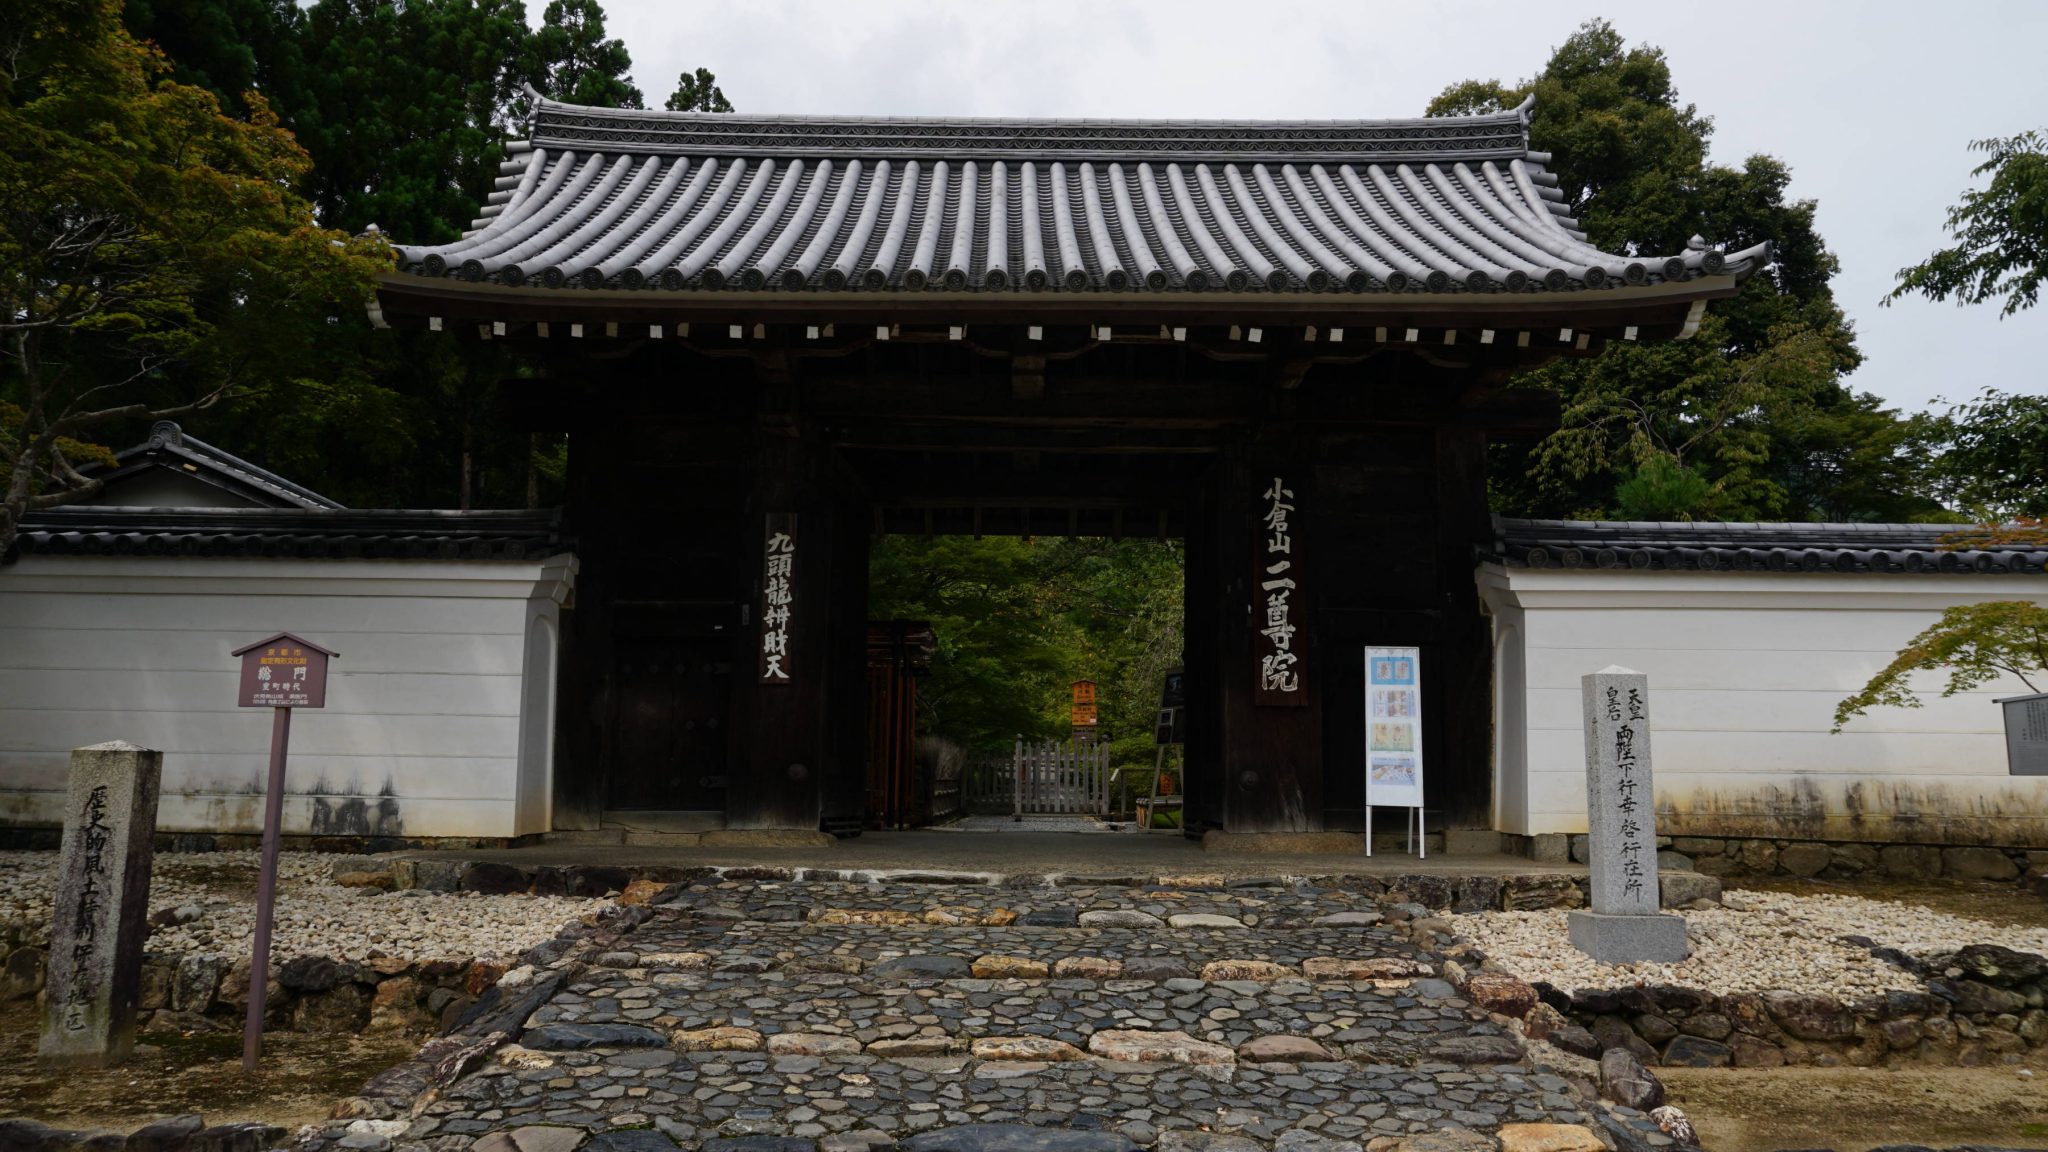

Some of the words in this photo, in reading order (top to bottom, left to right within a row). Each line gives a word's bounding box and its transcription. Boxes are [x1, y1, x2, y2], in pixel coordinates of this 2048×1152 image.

[1260, 477, 1298, 692] 小倉山二尊院
[262, 682, 301, 691] 室町時代
[1606, 686, 1622, 721] 皇后
[1628, 688, 1645, 721] 天皇
